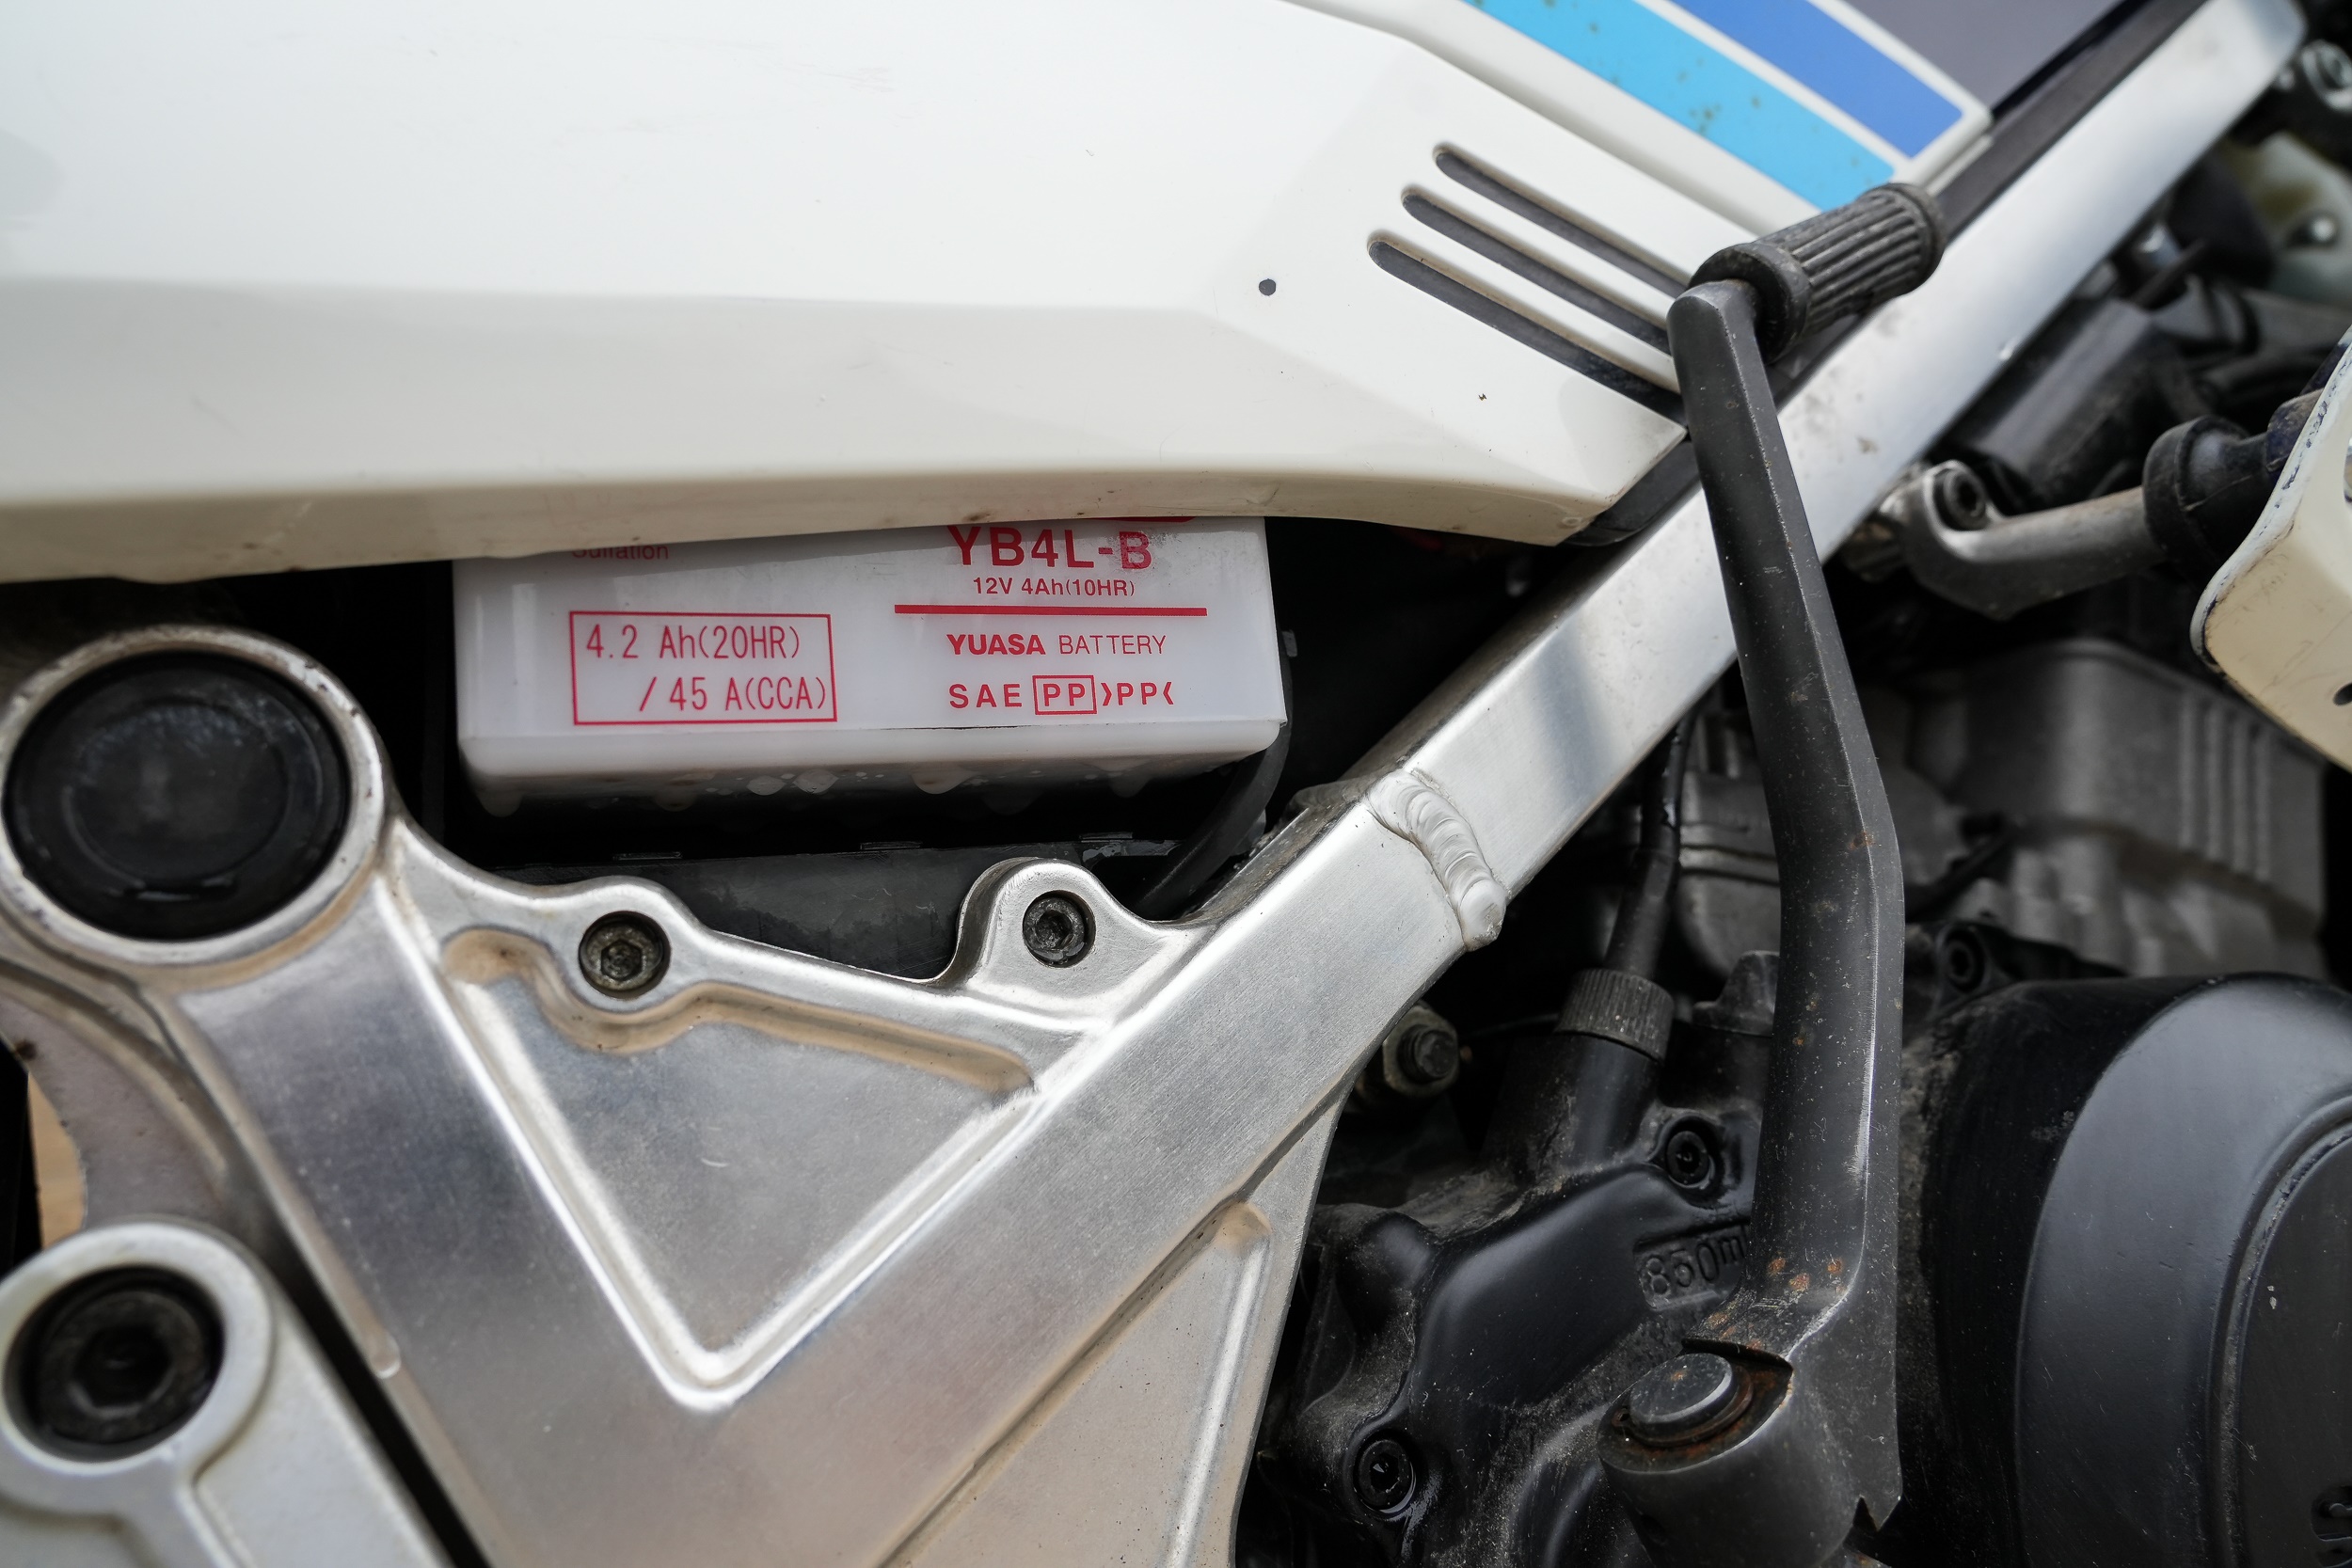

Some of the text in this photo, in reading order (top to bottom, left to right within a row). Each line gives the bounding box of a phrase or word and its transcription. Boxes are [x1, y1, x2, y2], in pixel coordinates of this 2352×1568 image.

[946, 526, 1152, 570] YB4L-B
[973, 577, 1135, 597] 12V 4Ah(10HR)
[586, 624, 800, 659] 4.2 Ah(20HR)
[946, 633, 1166, 656] YUASA BATTERY
[725, 676, 826, 711] A(CCA)
[948, 683, 1023, 710] SAE
[1042, 682, 1086, 707] PP
